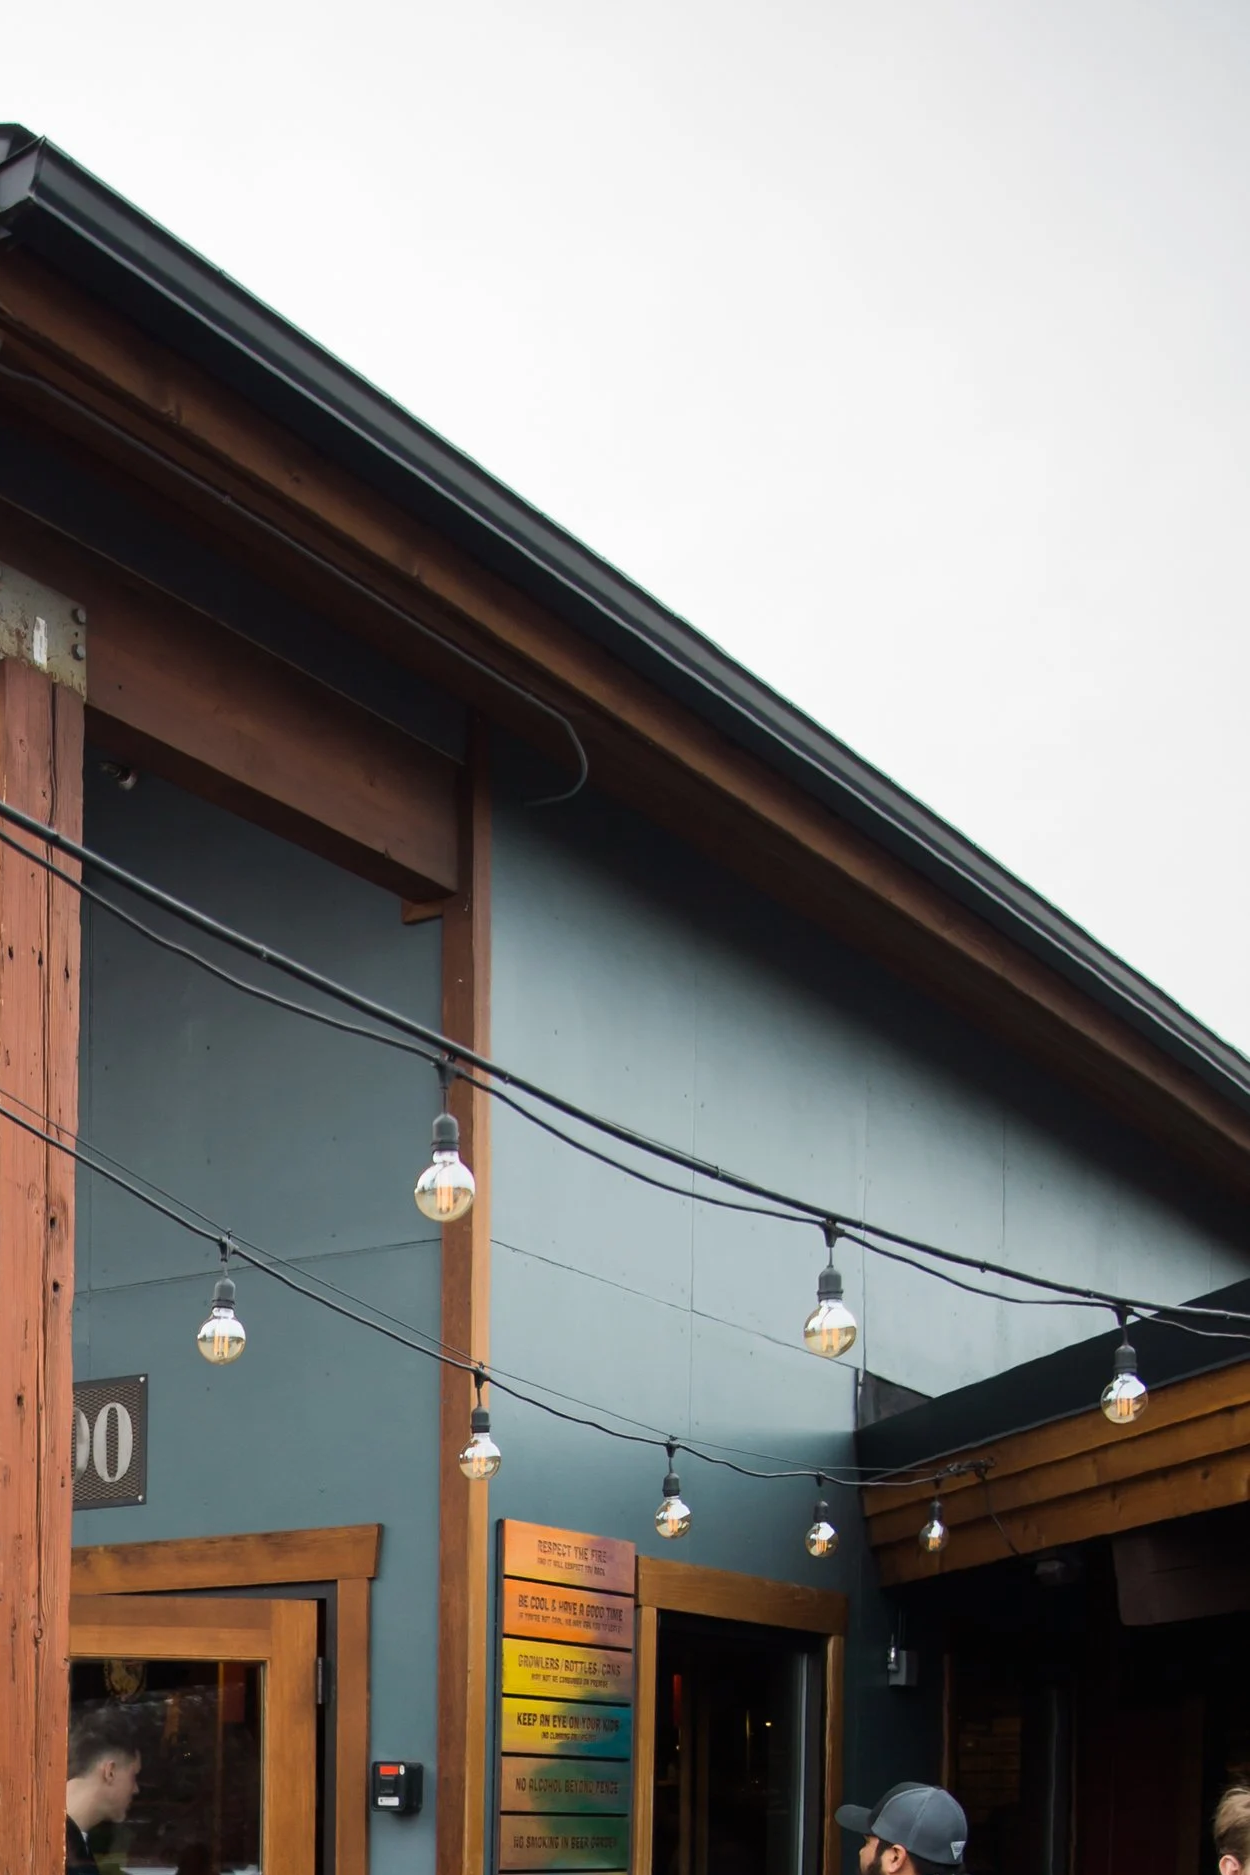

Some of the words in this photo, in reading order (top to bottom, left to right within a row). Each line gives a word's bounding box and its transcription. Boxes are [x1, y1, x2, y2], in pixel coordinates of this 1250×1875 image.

[537, 1539, 571, 1557] RESPECT
[574, 1546, 588, 1561] THE
[591, 1549, 607, 1563] FIRE
[518, 1594, 528, 1608] BE
[530, 1596, 549, 1611] COOL
[551, 1599, 557, 1612] &
[558, 1601, 577, 1616] HAVE
[579, 1603, 585, 1617] A
[586, 1604, 605, 1619] GOOD
[606, 1607, 623, 1622] TIME
[516, 1712, 538, 1727] KEEP
[539, 1713, 550, 1727] AN
[552, 1715, 567, 1728] EYE
[569, 1716, 579, 1729] ON
[581, 1716, 601, 1731] YOUR
[602, 1718, 620, 1732] KIDS
[515, 1778, 526, 1792] NO
[529, 1778, 562, 1793] ALCOHOL
[565, 1779, 593, 1794] BEYOND
[596, 1781, 618, 1795] FENCE
[513, 1836, 524, 1849] NO
[526, 1836, 559, 1849] SMOKING
[561, 1836, 568, 1849] IN
[571, 1836, 590, 1849] BEER
